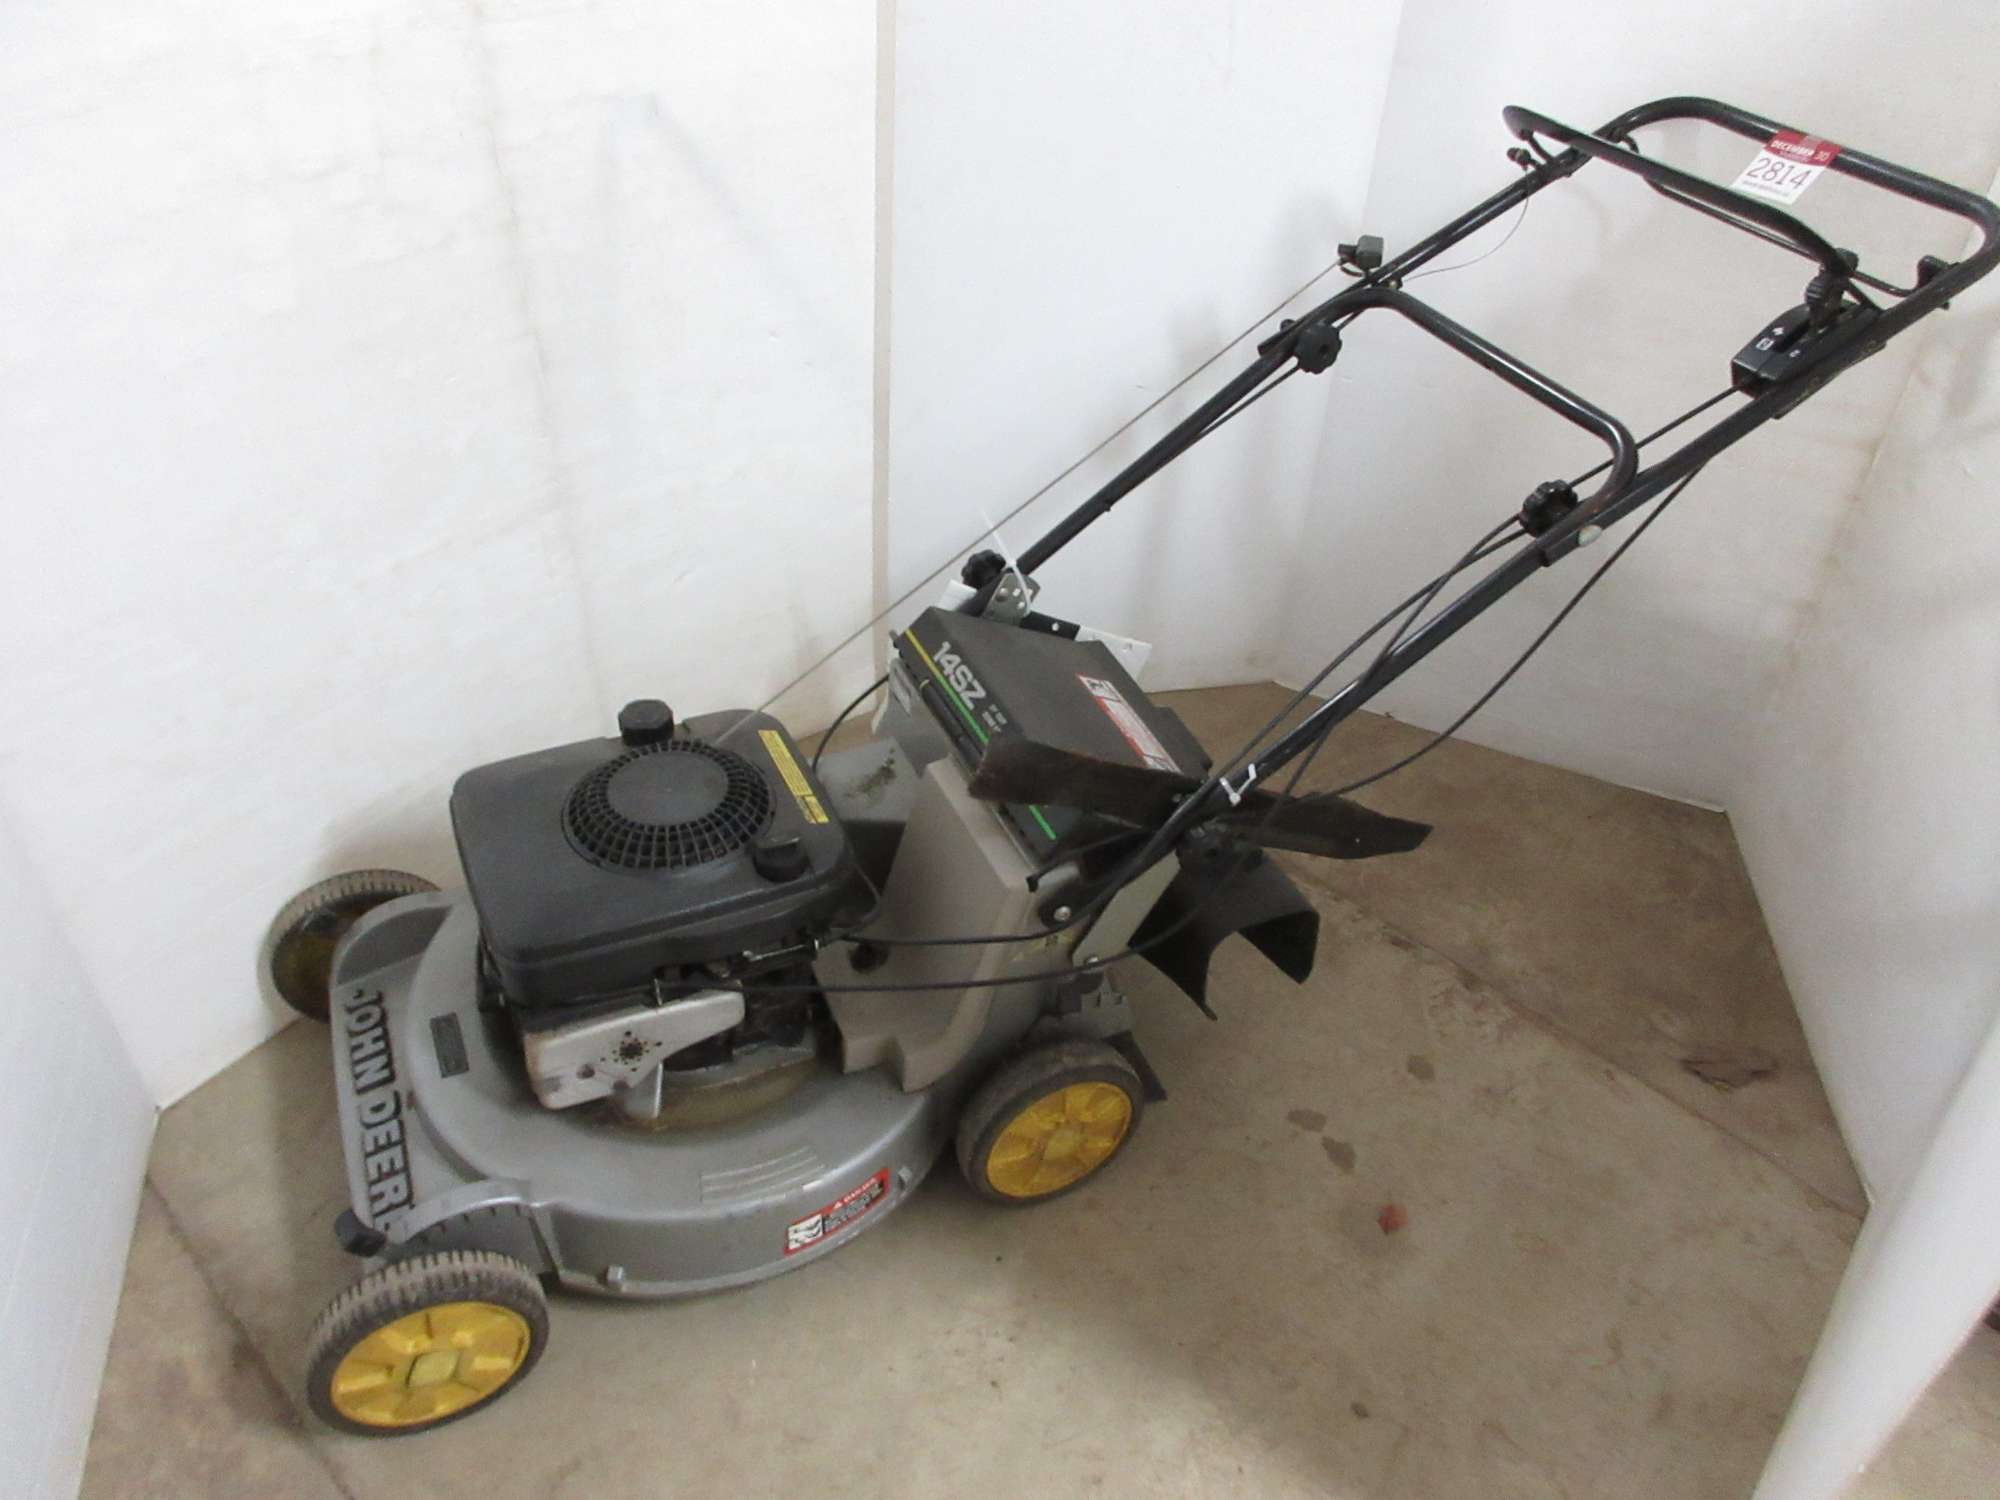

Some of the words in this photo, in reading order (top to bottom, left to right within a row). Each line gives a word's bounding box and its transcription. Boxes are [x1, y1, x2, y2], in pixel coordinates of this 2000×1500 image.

[1745, 157, 1813, 190] 2814
[932, 641, 987, 711] 14SZ
[345, 988, 397, 1095] JOHN
